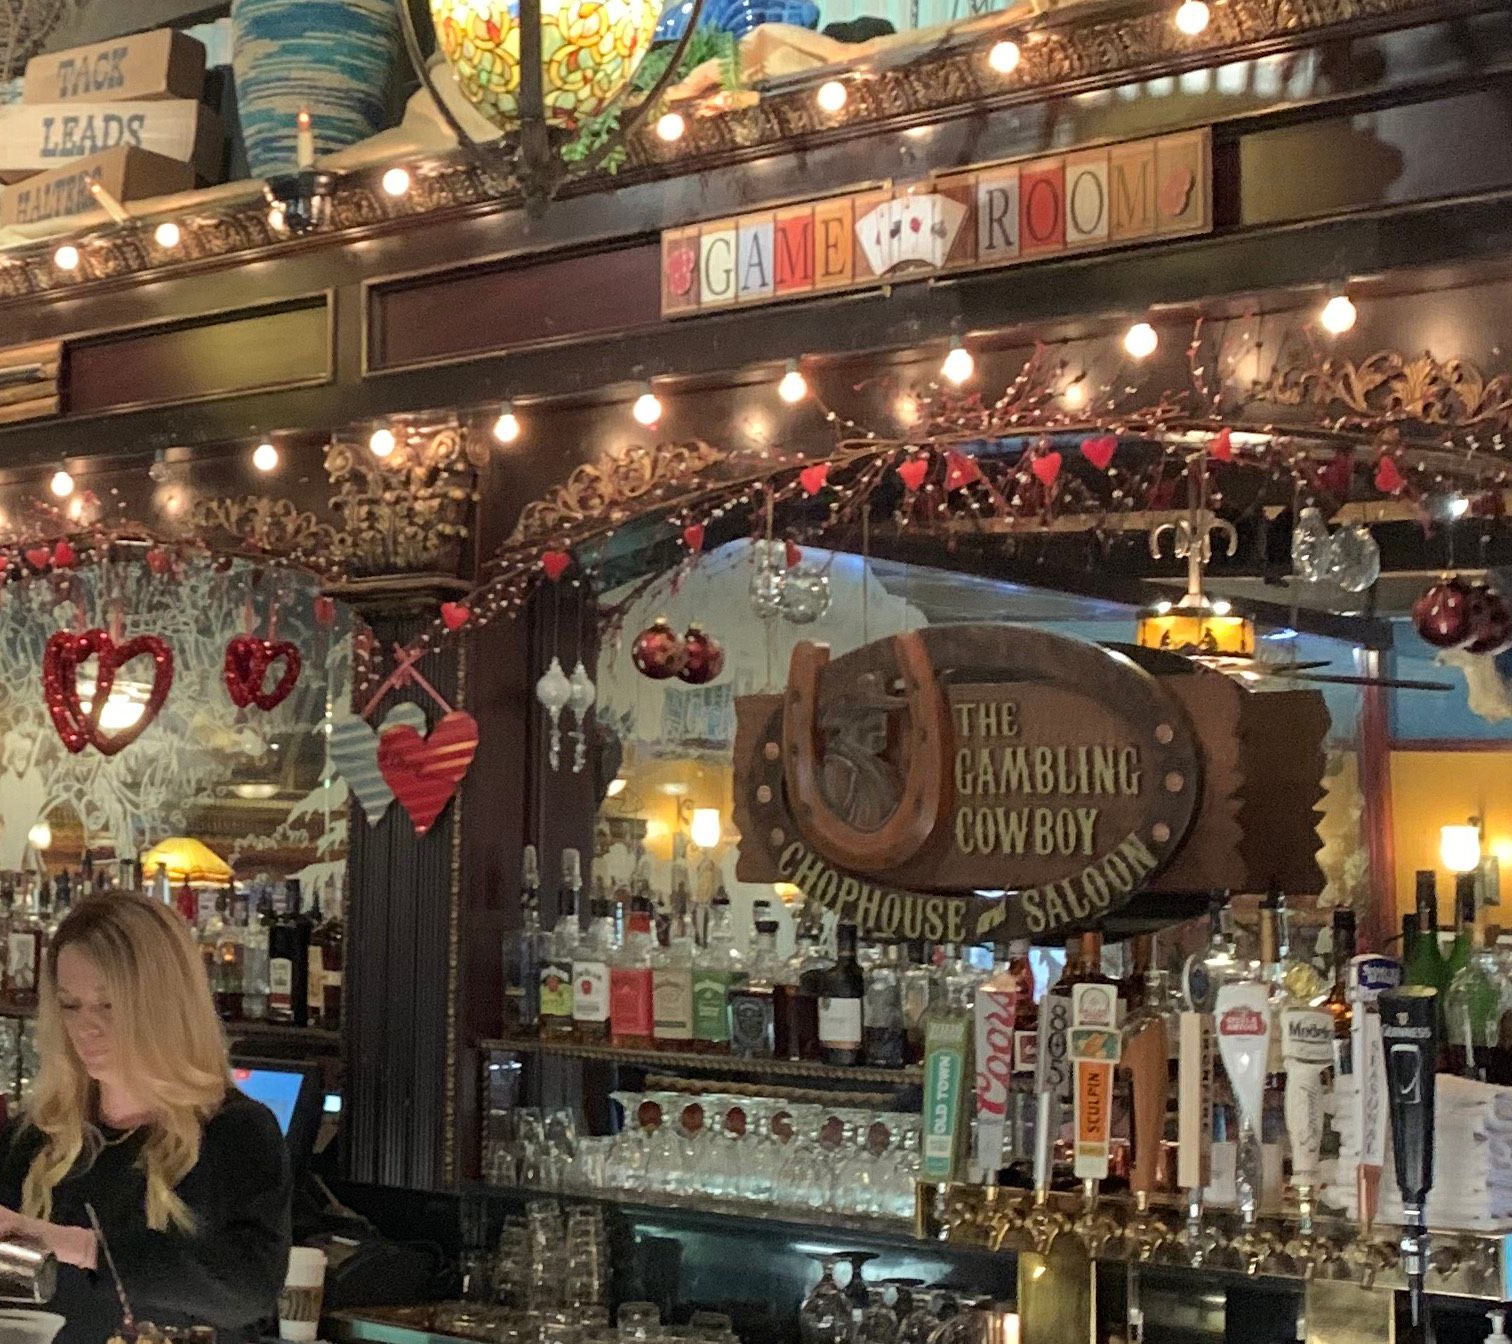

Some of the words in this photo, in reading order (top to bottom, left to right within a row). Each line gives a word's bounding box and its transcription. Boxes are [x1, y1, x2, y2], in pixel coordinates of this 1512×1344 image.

[57, 46, 129, 98] TACK
[41, 114, 144, 158] LEADS
[704, 216, 846, 297] GAME
[983, 159, 1150, 251] ROOM
[954, 701, 1020, 737] THE
[954, 747, 1142, 797] GAMBLING
[954, 806, 1099, 856] COWBOY
[777, 841, 968, 944] CHOPHOUSE
[1020, 831, 1160, 935] SALOON
[977, 991, 1017, 1115] Coors
[1046, 1004, 1067, 1086] 805
[935, 1055, 951, 1099] TOWN
[1087, 1071, 1100, 1134] SCULPIN
[933, 1104, 948, 1135] OLD
